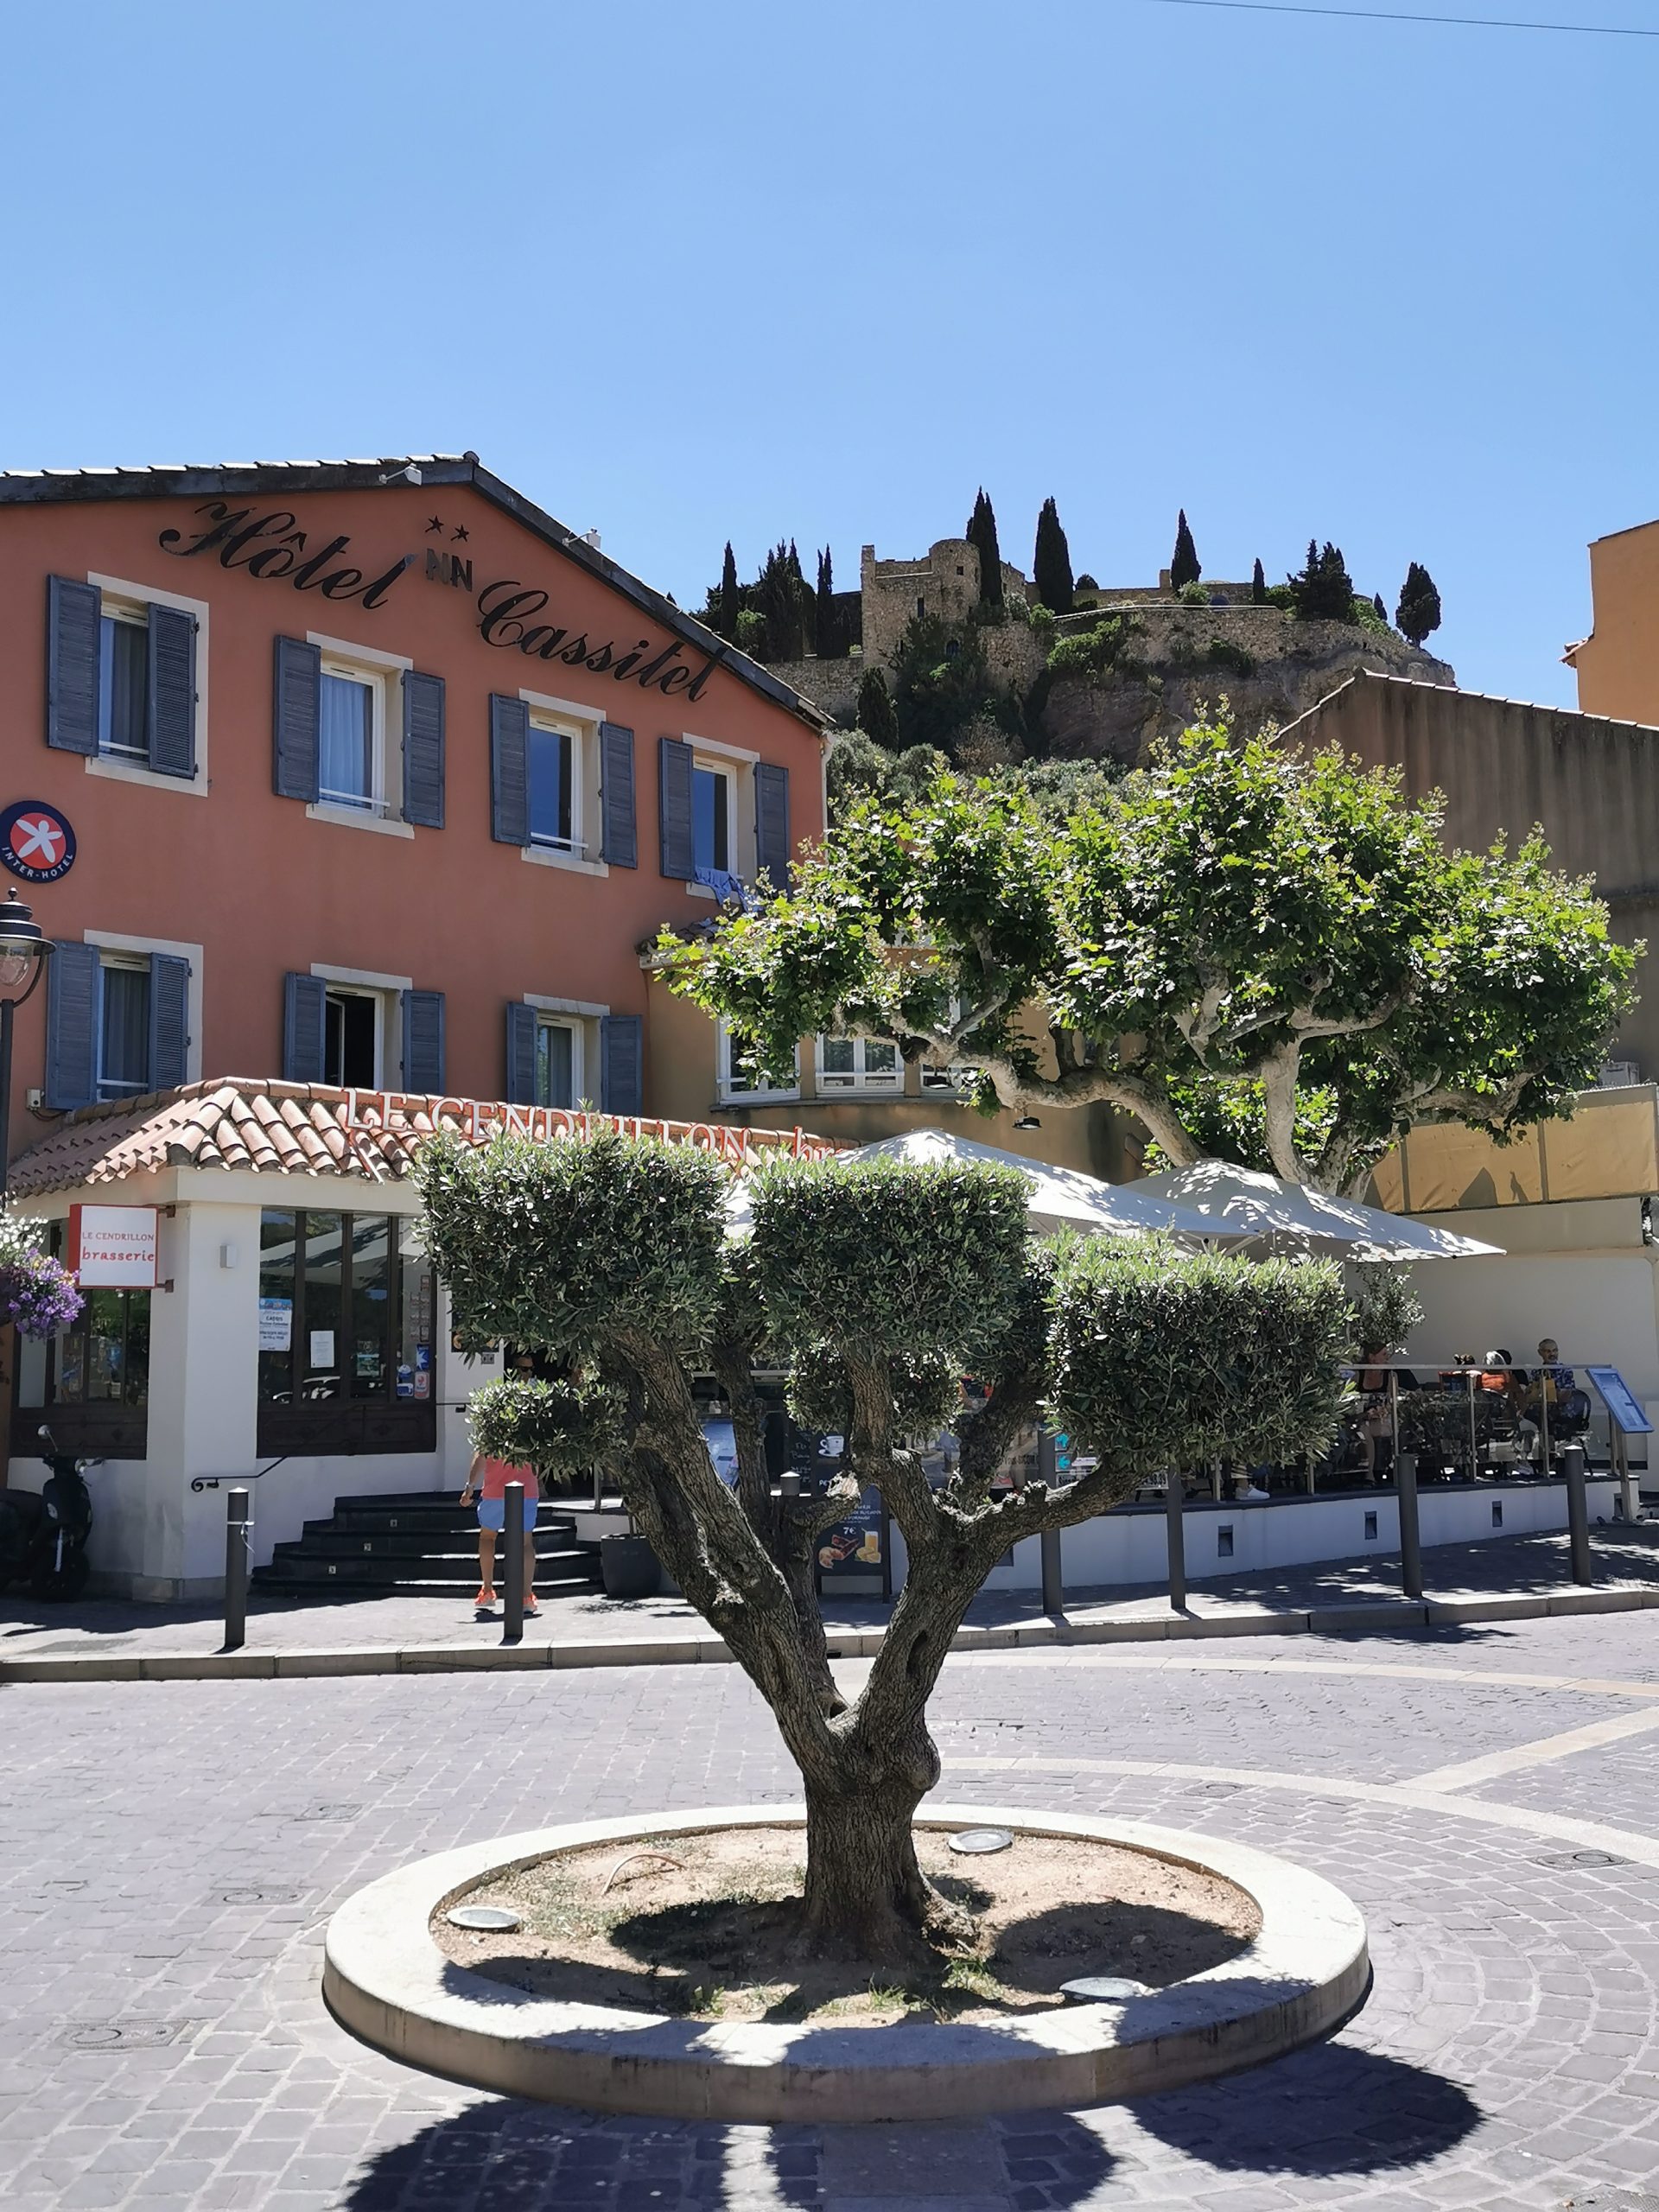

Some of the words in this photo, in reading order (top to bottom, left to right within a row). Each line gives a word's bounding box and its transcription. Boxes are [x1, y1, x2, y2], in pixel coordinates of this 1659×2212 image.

[159, 501, 418, 610] Hôtel
[477, 581, 728, 702] Cassitel
[2, 847, 73, 879] INTER-HOTEL
[345, 1087, 409, 1133] LE
[429, 1097, 750, 1160] CENDION
[82, 1246, 154, 1262] brasserie
[96, 1232, 154, 1241] CENDRILLON
